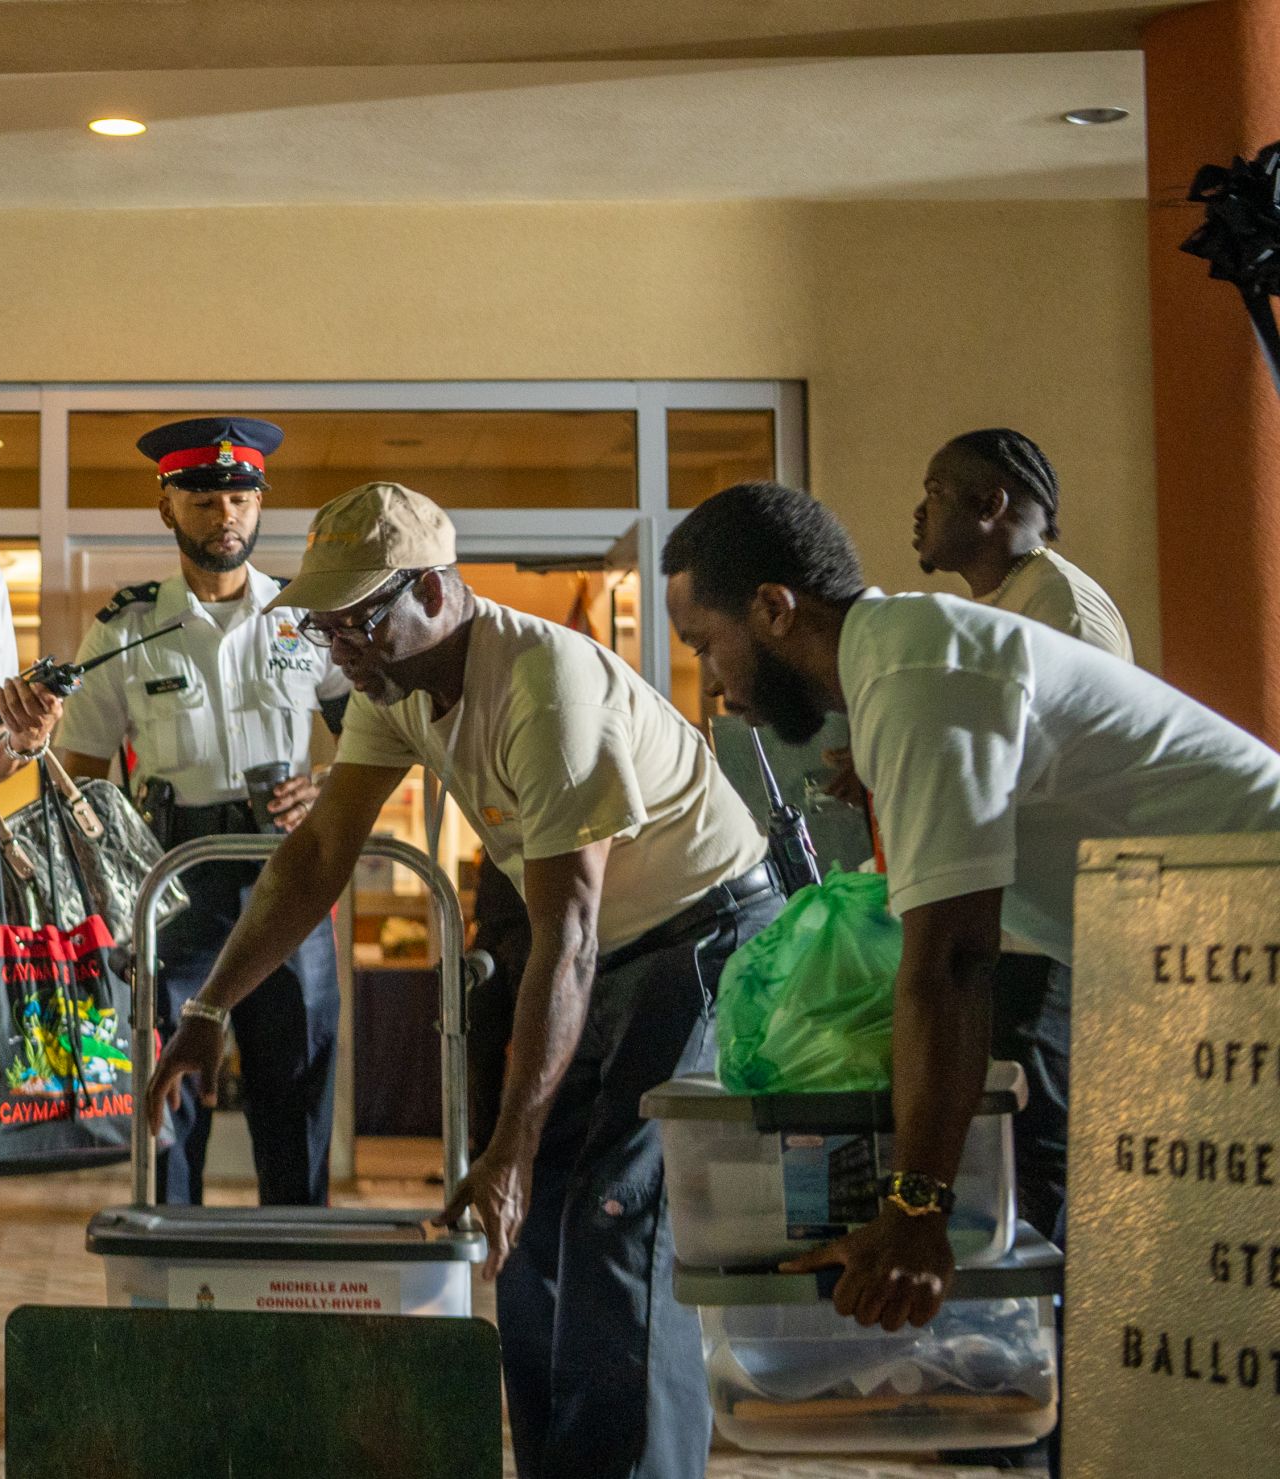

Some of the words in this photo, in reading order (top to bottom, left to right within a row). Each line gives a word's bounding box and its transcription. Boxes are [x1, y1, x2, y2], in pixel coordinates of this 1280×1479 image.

[269, 656, 314, 673] POLICE
[1153, 943, 1280, 986] ELECT
[0, 1099, 70, 1124] CAYMAN
[1116, 1134, 1274, 1187] GEORGE
[270, 1281, 336, 1293] MICHELLE
[339, 1281, 368, 1293] ANN
[256, 1296, 382, 1310] CONNOLLY-RIVERS
